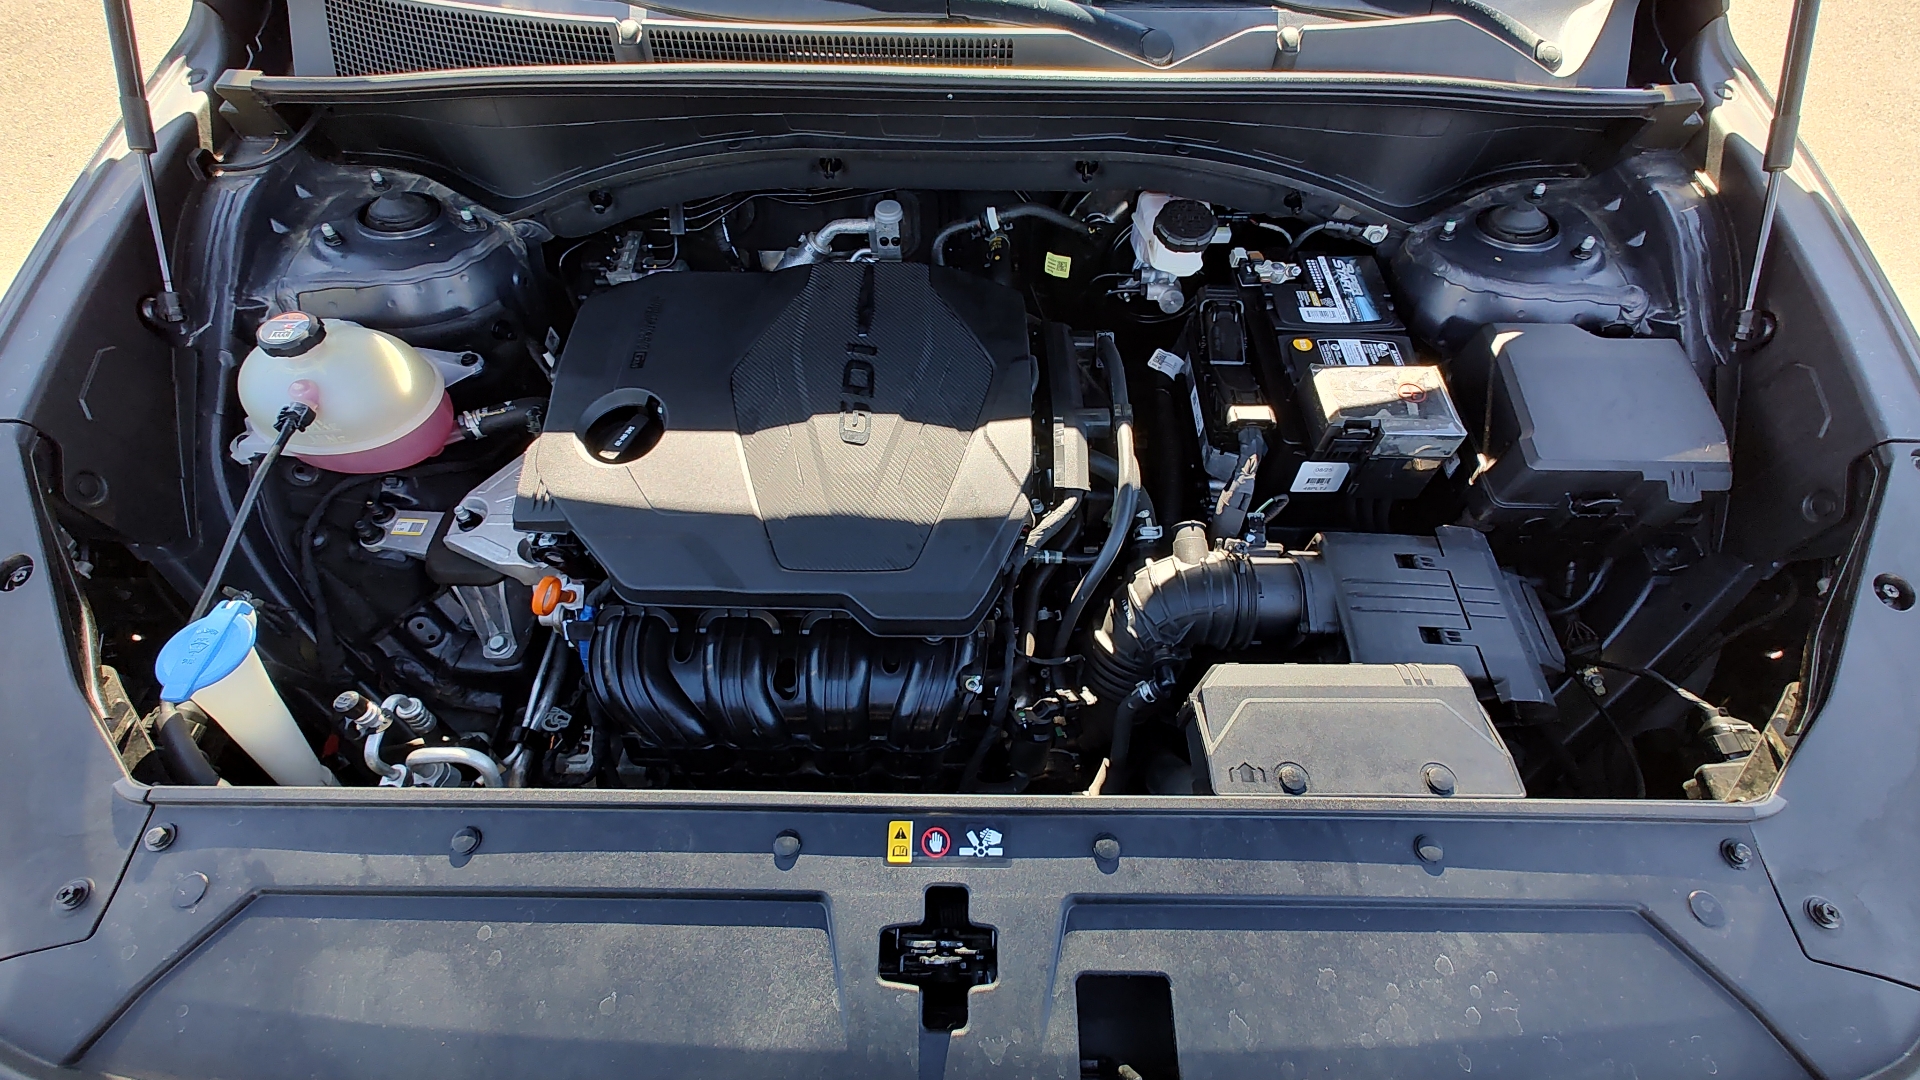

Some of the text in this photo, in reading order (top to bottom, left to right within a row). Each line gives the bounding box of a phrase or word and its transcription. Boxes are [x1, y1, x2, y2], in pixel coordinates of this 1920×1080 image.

[1332, 259, 1353, 296] START
[1345, 263, 1364, 296] SUPER
[838, 343, 878, 446] GDI
